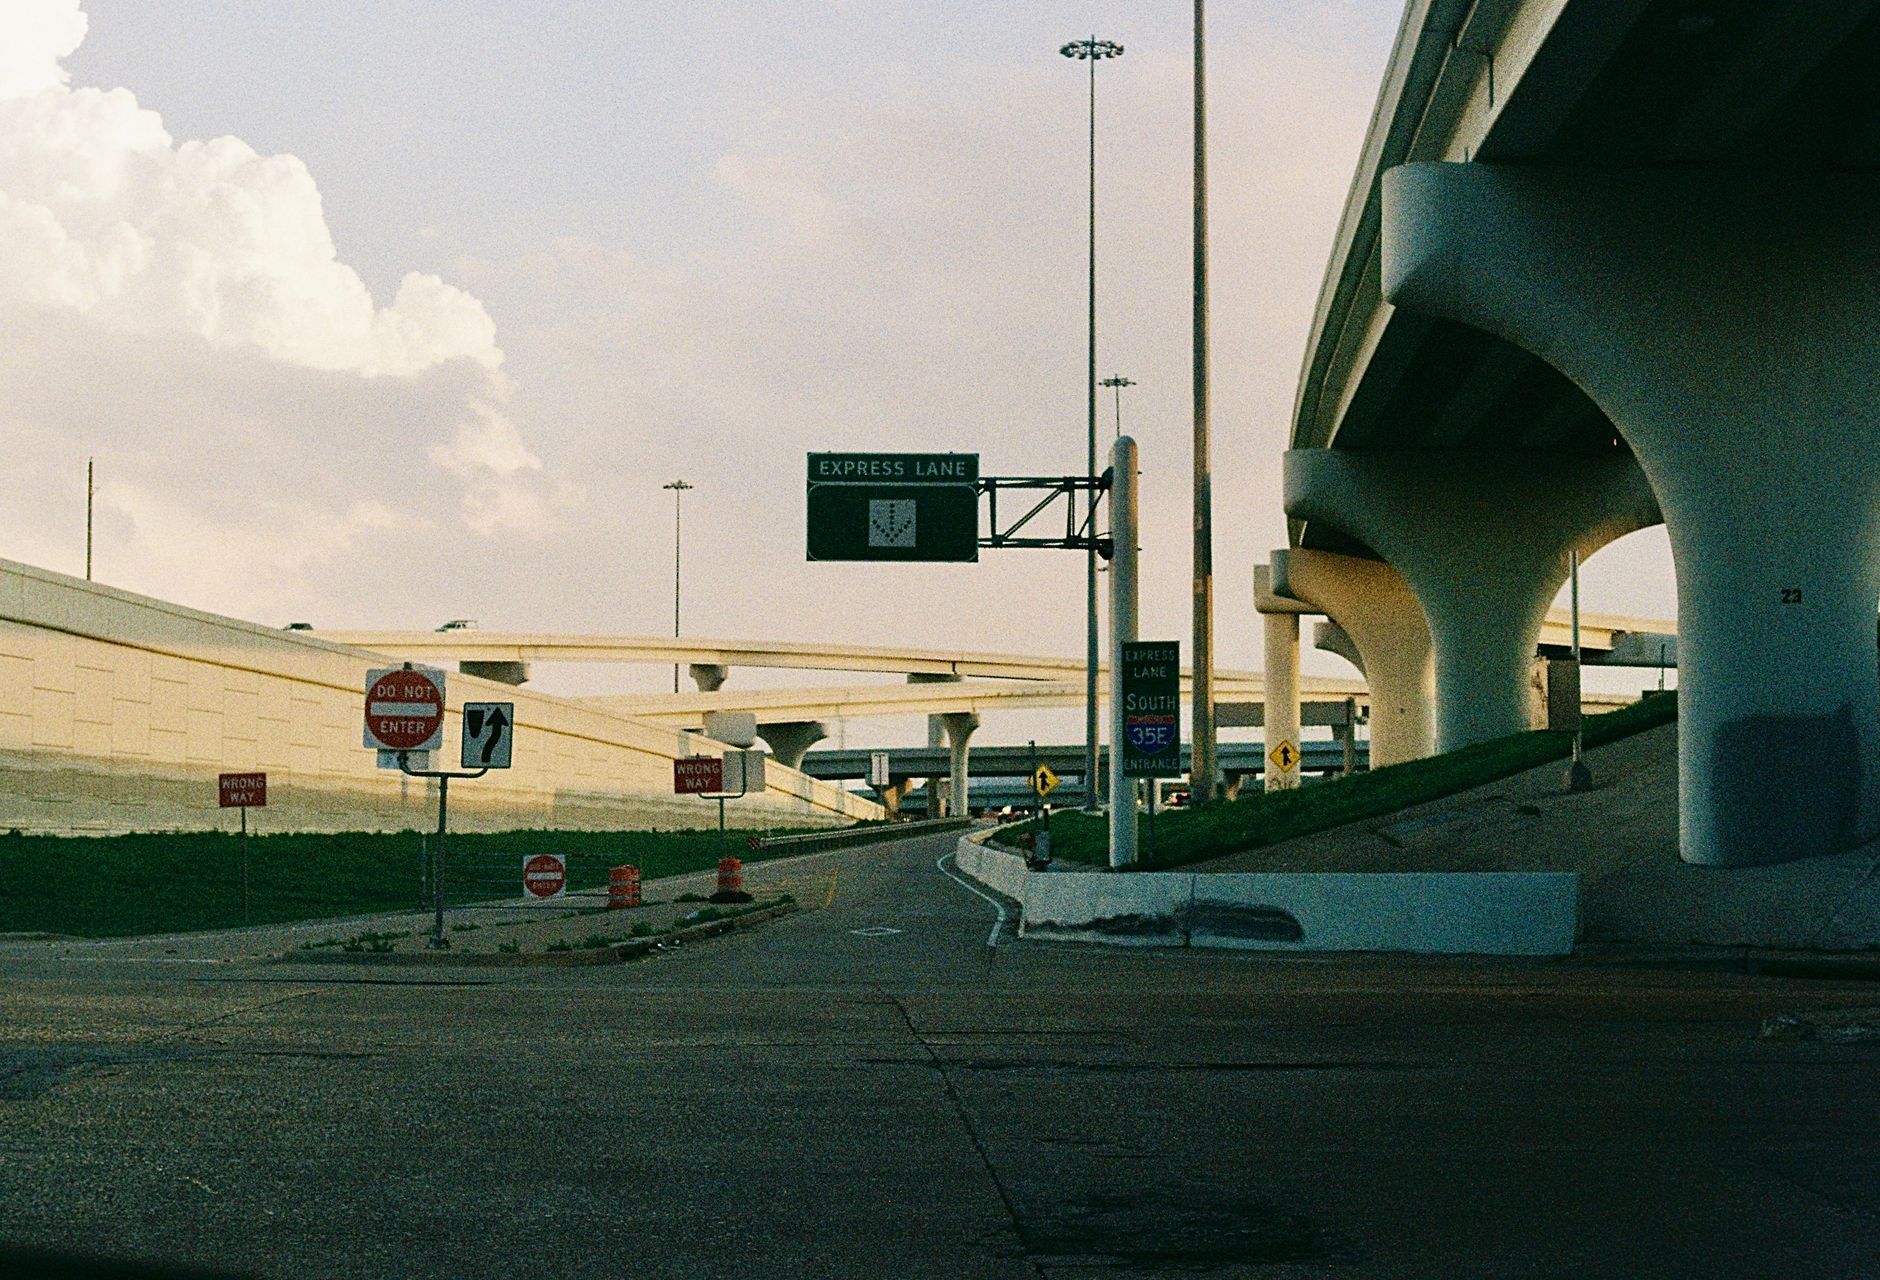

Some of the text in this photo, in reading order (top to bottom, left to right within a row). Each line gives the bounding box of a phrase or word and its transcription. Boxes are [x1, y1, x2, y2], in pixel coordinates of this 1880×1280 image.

[819, 460, 965, 476] EXPRESS LANE
[1781, 588, 1801, 604] 23
[1125, 650, 1175, 661] EXPRESS
[1134, 667, 1167, 678] LANE
[377, 684, 433, 699] DO NOT
[380, 720, 425, 734] ENTER
[1132, 727, 1168, 745] 35E
[677, 763, 720, 774] WRONG
[1124, 758, 1178, 769] ENTRANCE
[222, 777, 264, 789] WRONG
[685, 778, 711, 789] WAY
[231, 792, 255, 803] WAY
